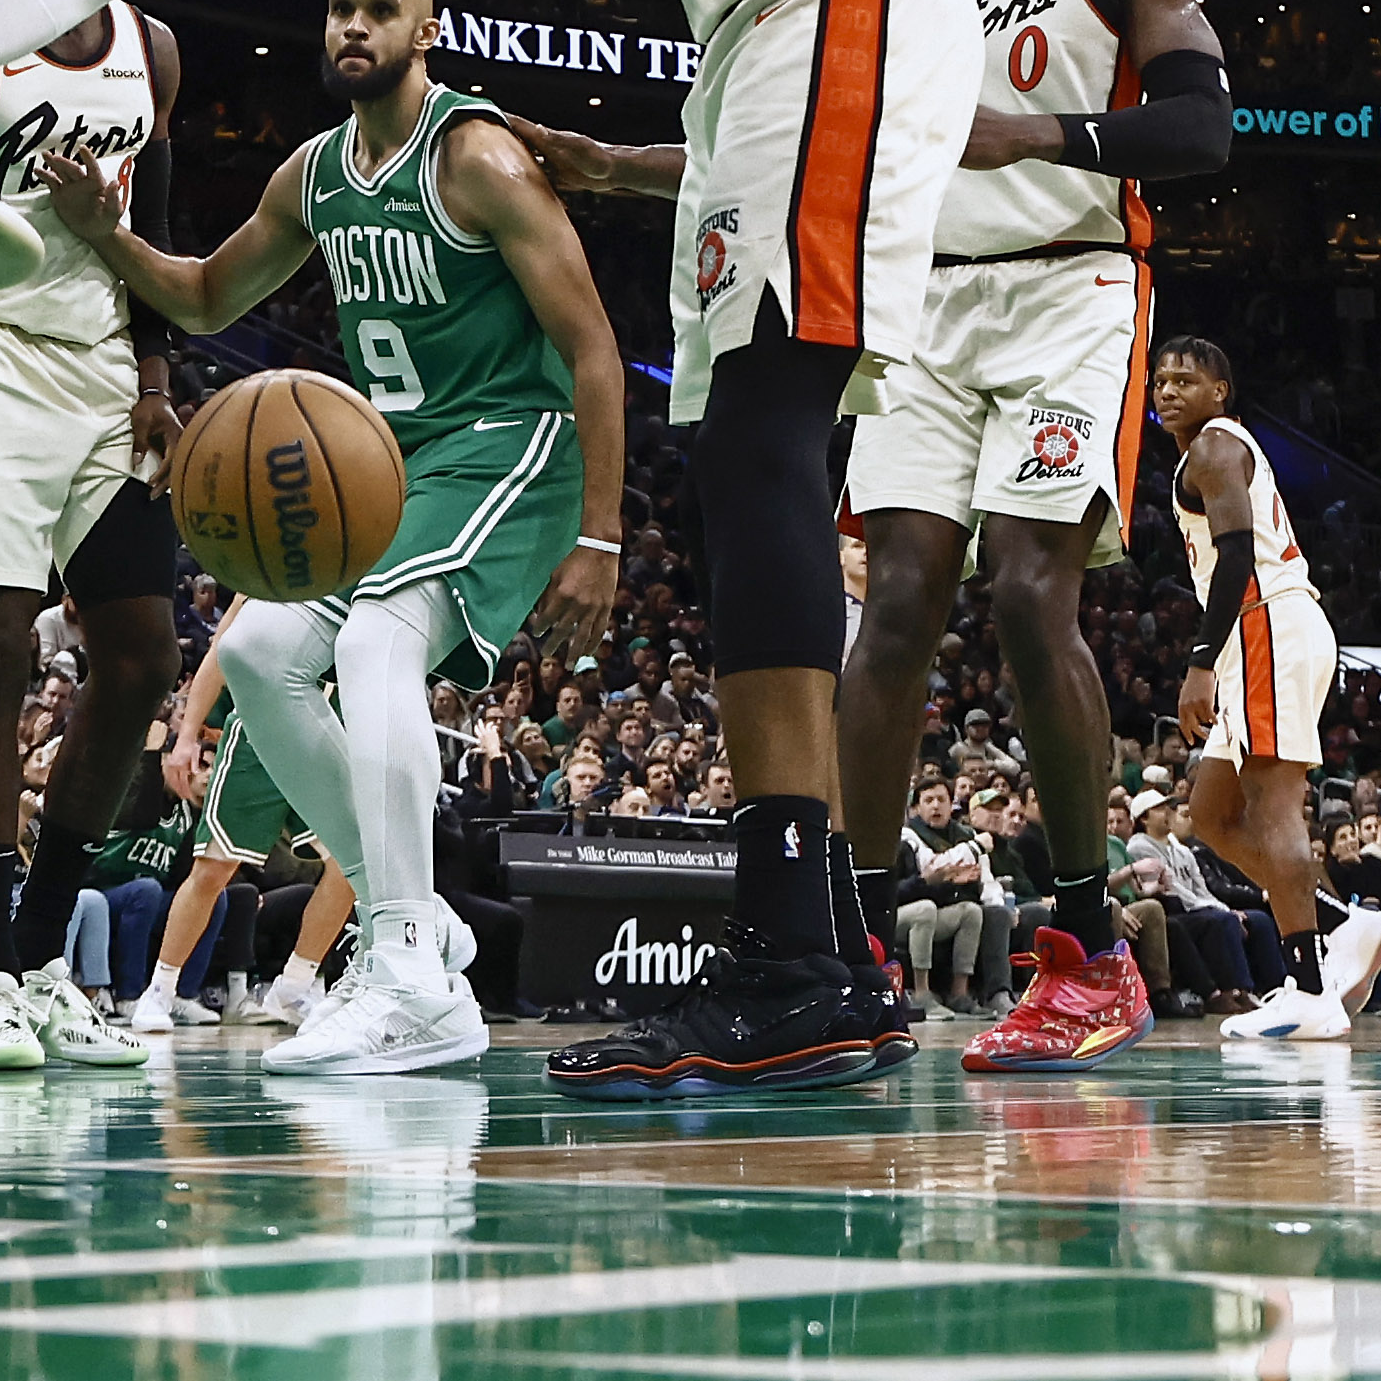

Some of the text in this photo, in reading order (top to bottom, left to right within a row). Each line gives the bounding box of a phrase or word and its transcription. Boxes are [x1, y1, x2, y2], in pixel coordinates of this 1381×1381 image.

[1008, 25, 1049, 92] 0
[1334, 106, 1373, 138] of
[384, 196, 421, 212] Amica
[317, 224, 447, 307] BOSTON
[355, 318, 427, 412] 9
[1028, 408, 1093, 440] PISTONS
[1015, 456, 1085, 483] Detroit
[265, 436, 320, 590] Wilson
[576, 845, 606, 862] Mike
[607, 847, 656, 865] Gorman
[656, 849, 715, 867] Broadcast
